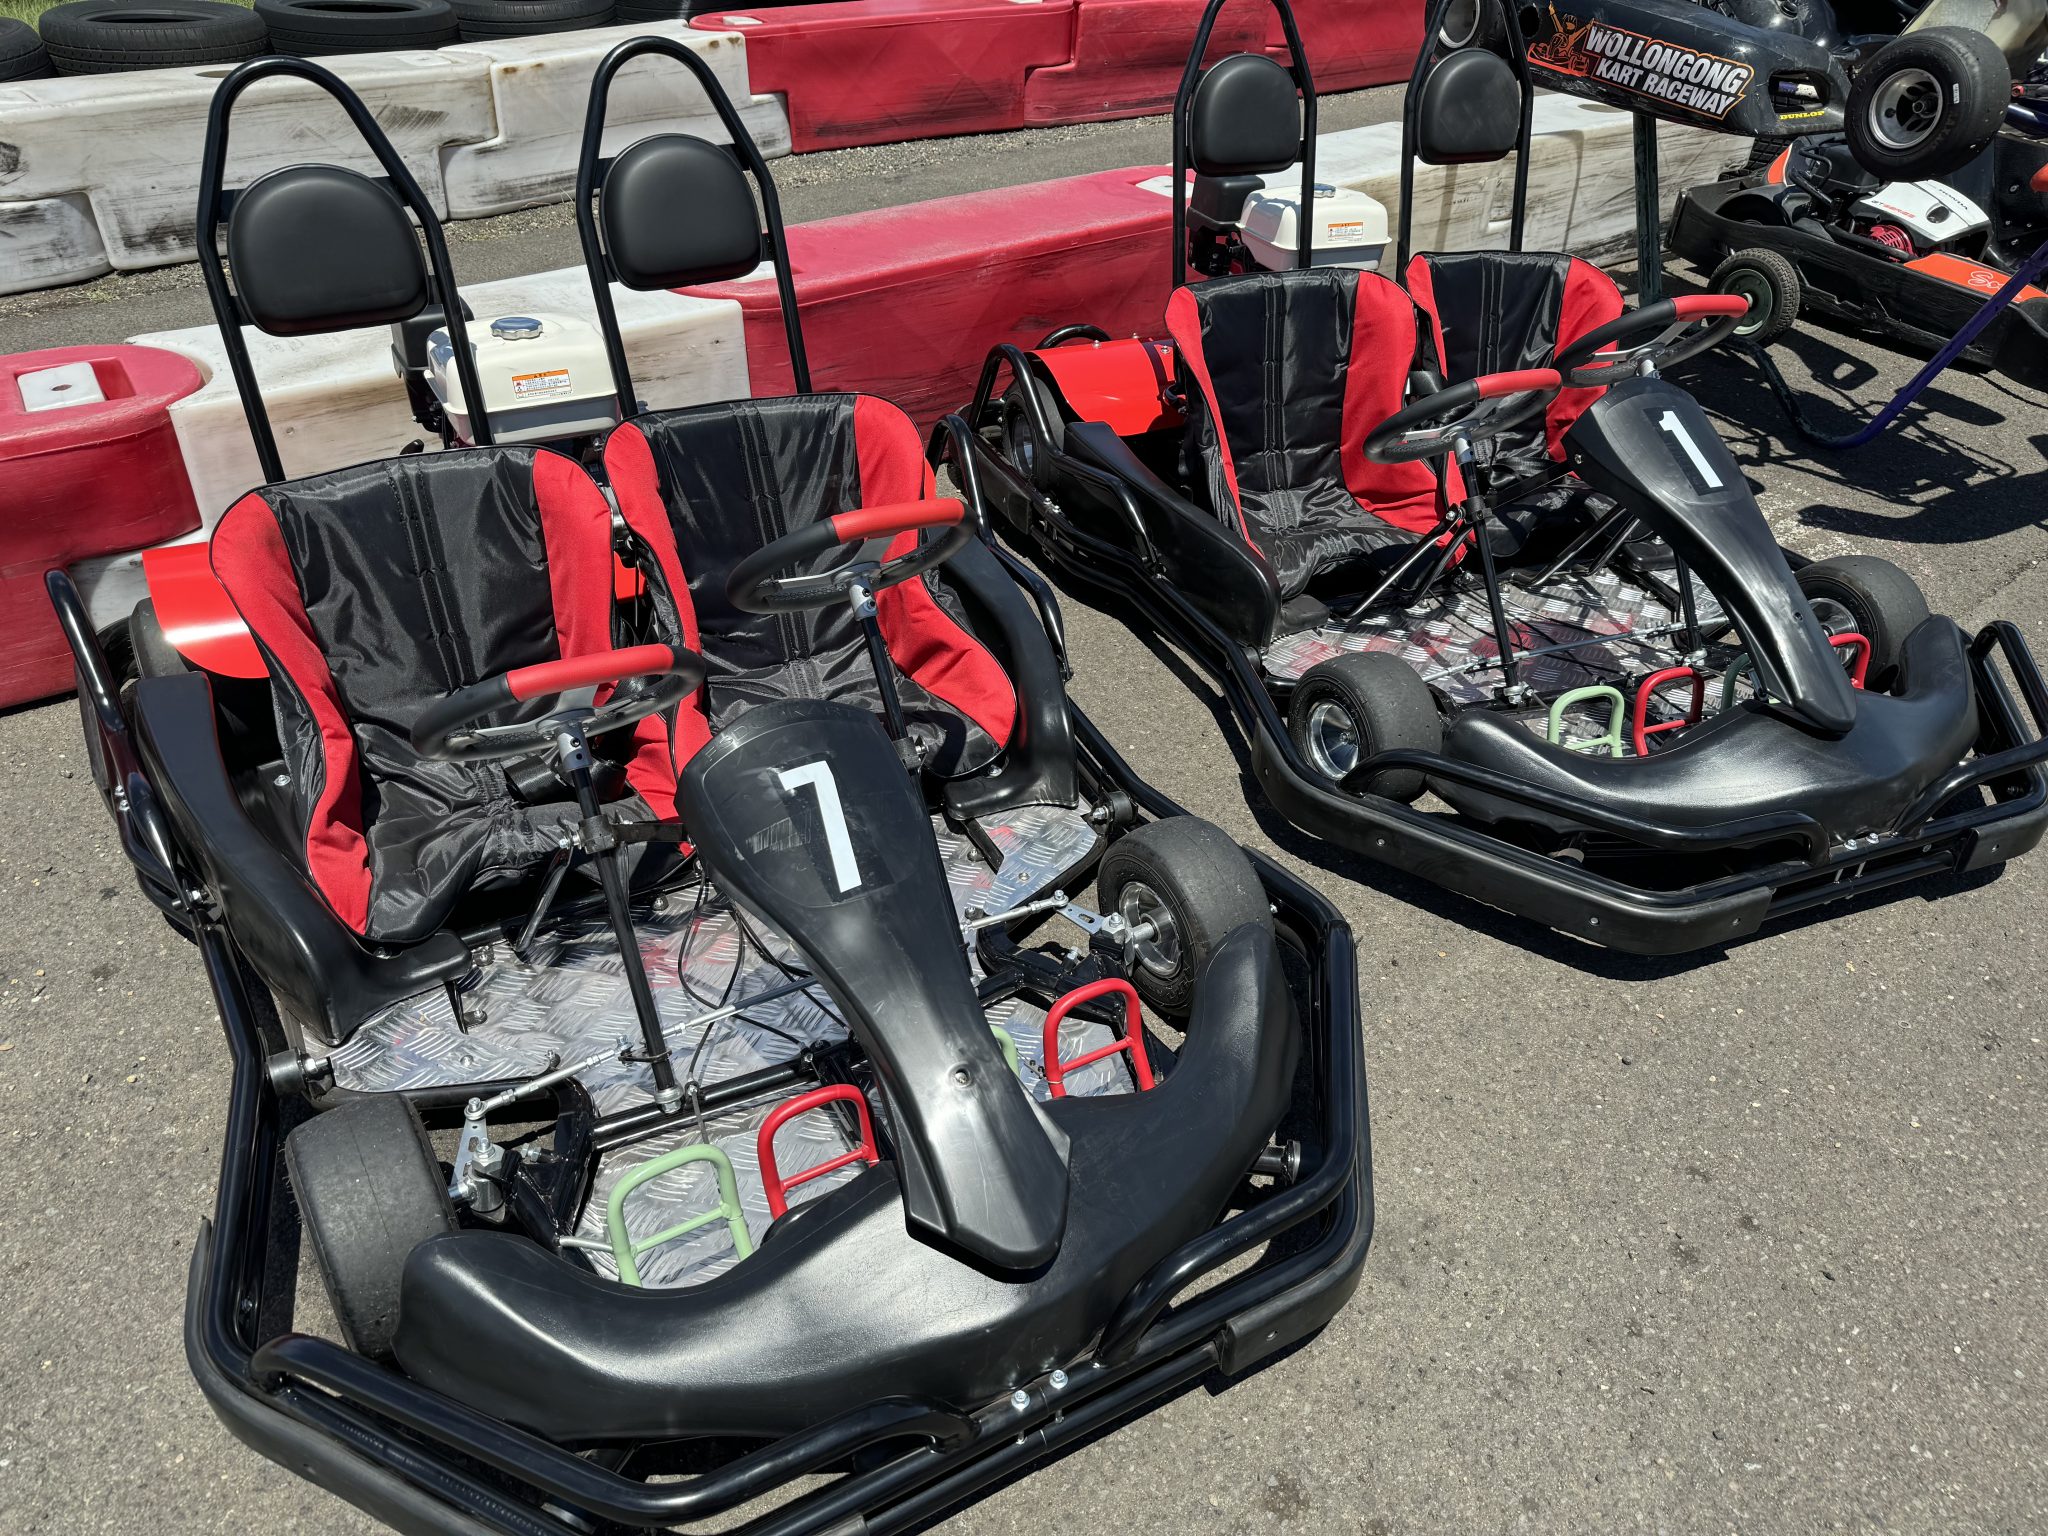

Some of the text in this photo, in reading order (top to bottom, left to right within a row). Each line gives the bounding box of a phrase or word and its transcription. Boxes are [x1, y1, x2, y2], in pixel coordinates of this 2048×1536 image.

[1585, 26, 1748, 94] WOLLONGONG
[1596, 57, 1736, 115] KART RACEWAY
[1779, 110, 1825, 120] DUNLOP
[1658, 410, 1724, 488] 1
[777, 759, 863, 893] 7
